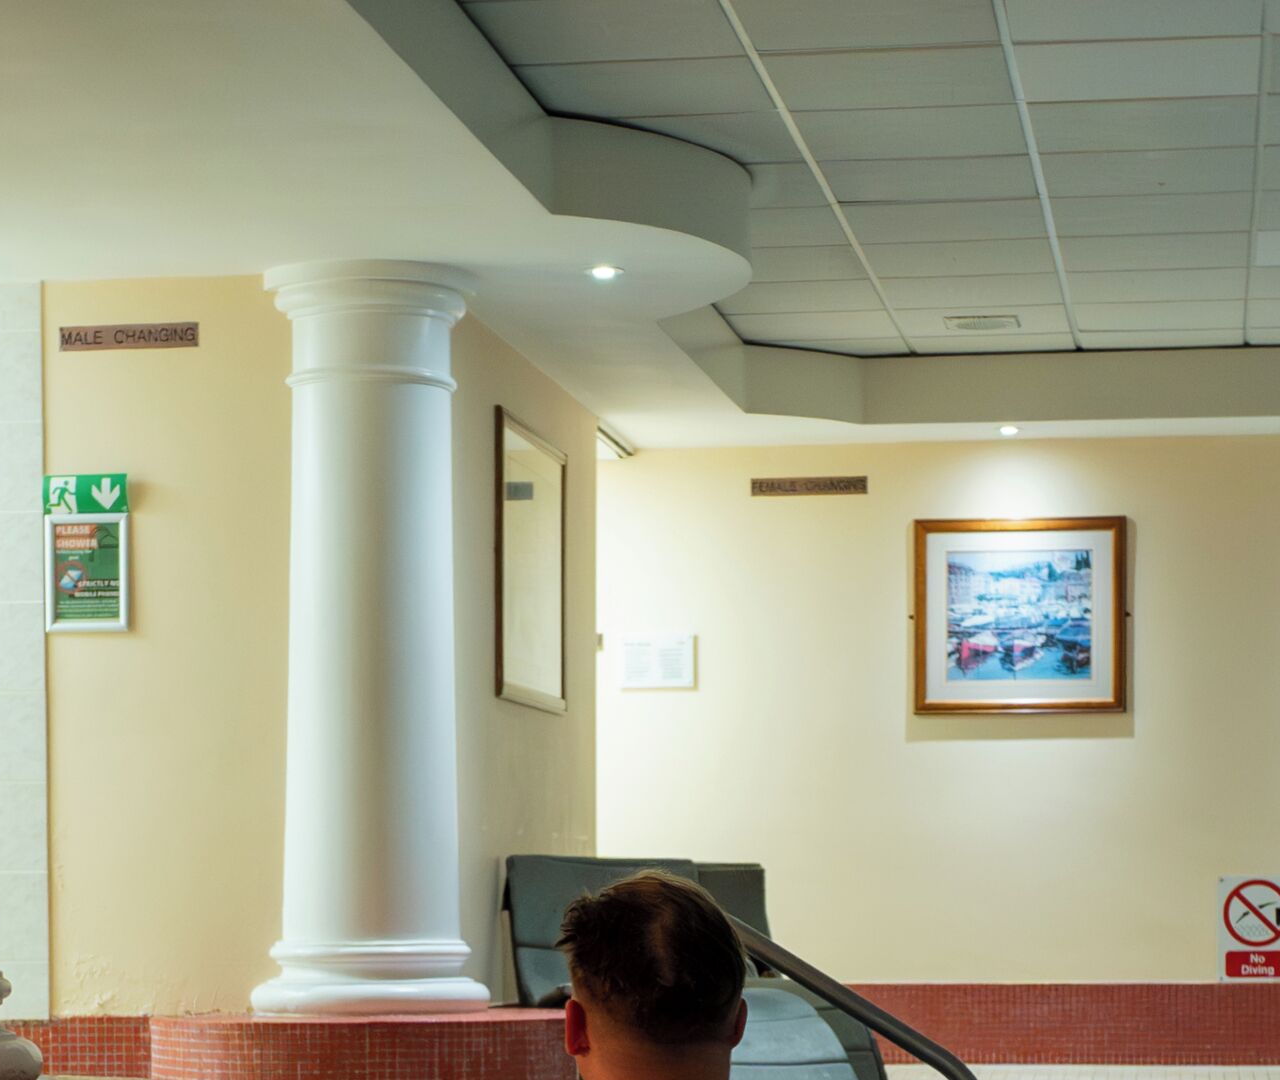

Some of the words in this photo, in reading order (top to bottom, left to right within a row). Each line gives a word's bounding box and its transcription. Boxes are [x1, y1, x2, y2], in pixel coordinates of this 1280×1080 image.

[61, 330, 104, 346] MALE
[113, 327, 196, 344] CHANGING
[751, 480, 798, 493] FEMALE
[55, 525, 90, 536] PLEASE
[55, 538, 98, 549] SHOWER
[1250, 953, 1265, 964] No
[1241, 964, 1275, 976] Diving
